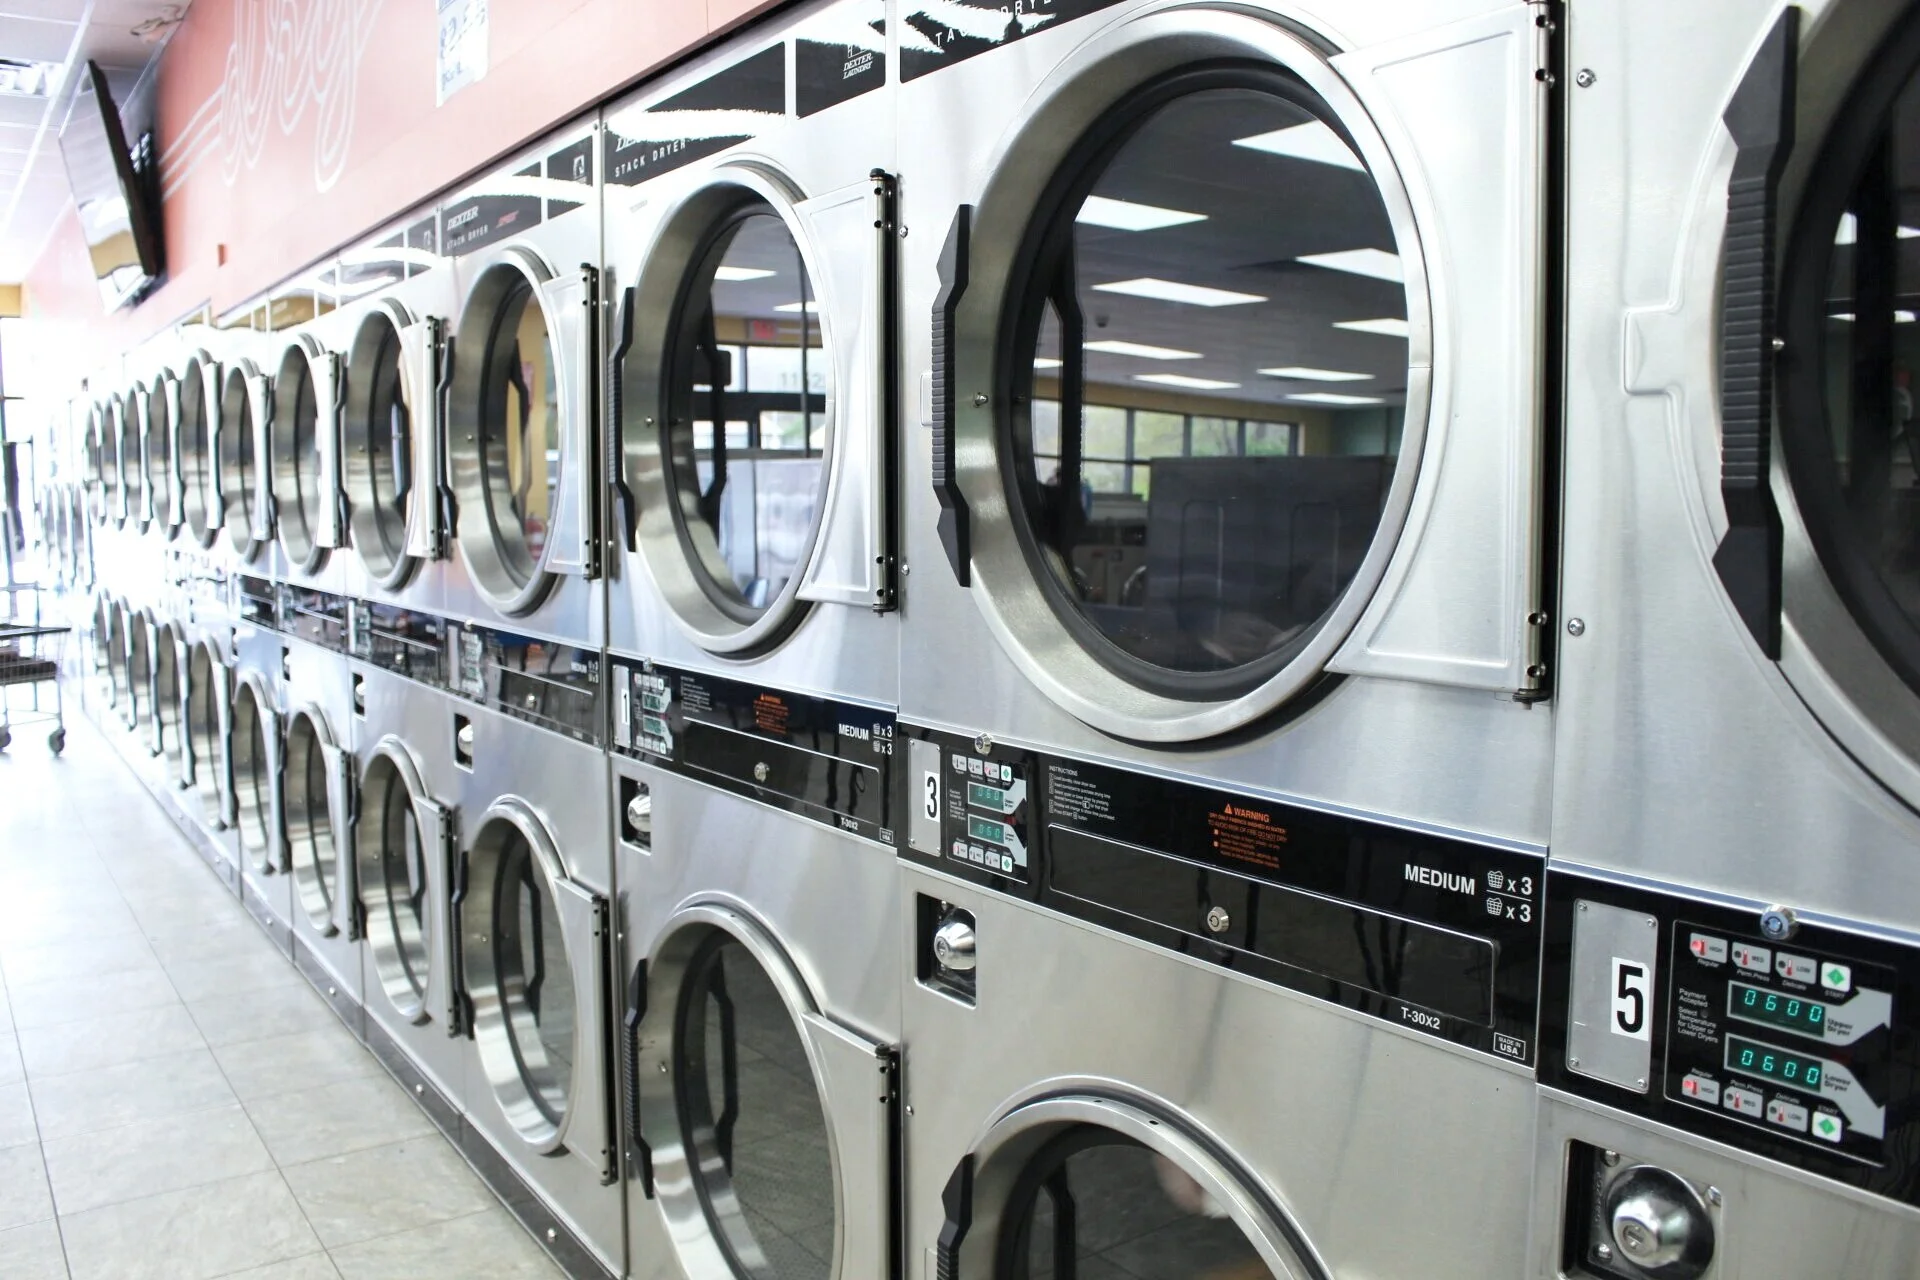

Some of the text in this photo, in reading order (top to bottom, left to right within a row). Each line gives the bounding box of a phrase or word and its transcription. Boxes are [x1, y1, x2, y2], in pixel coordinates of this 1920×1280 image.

[843, 53, 873, 71] DEXTER
[843, 61, 873, 79] LAUNDRY
[615, 154, 645, 177] STACK
[652, 138, 686, 161] DRYER
[838, 723, 869, 740] MEDIUM
[887, 725, 893, 738] 3
[887, 743, 893, 756] 3
[926, 775, 938, 819] 3
[1234, 808, 1270, 823] WARNING
[1405, 863, 1533, 896] MEDIUM x 3
[1506, 904, 1532, 923] x 3
[1697, 958, 1719, 968] Regular
[1796, 965, 1811, 974] LOW
[1616, 963, 1644, 1034] 5
[1679, 987, 1706, 1000] Payment
[1825, 989, 1845, 999] START
[1679, 995, 1708, 1008] Accepted
[1744, 989, 1822, 1022] 0600
[1678, 1006, 1697, 1016] Select
[1401, 1006, 1440, 1030] T-30X2
[1679, 1013, 1717, 1029] Temperature
[1828, 1017, 1853, 1030] Upper
[1687, 1022, 1706, 1033] Upper
[1827, 1025, 1850, 1036] Dryer
[1498, 1036, 1514, 1046] MADE
[1678, 1027, 1719, 1043] Lower Dryers
[1500, 1043, 1519, 1056] USA
[1741, 1049, 1820, 1084] 0600
[1824, 1080, 1849, 1092] Dryer
[1825, 1073, 1851, 1086] Lower
[1818, 1104, 1838, 1115] START
